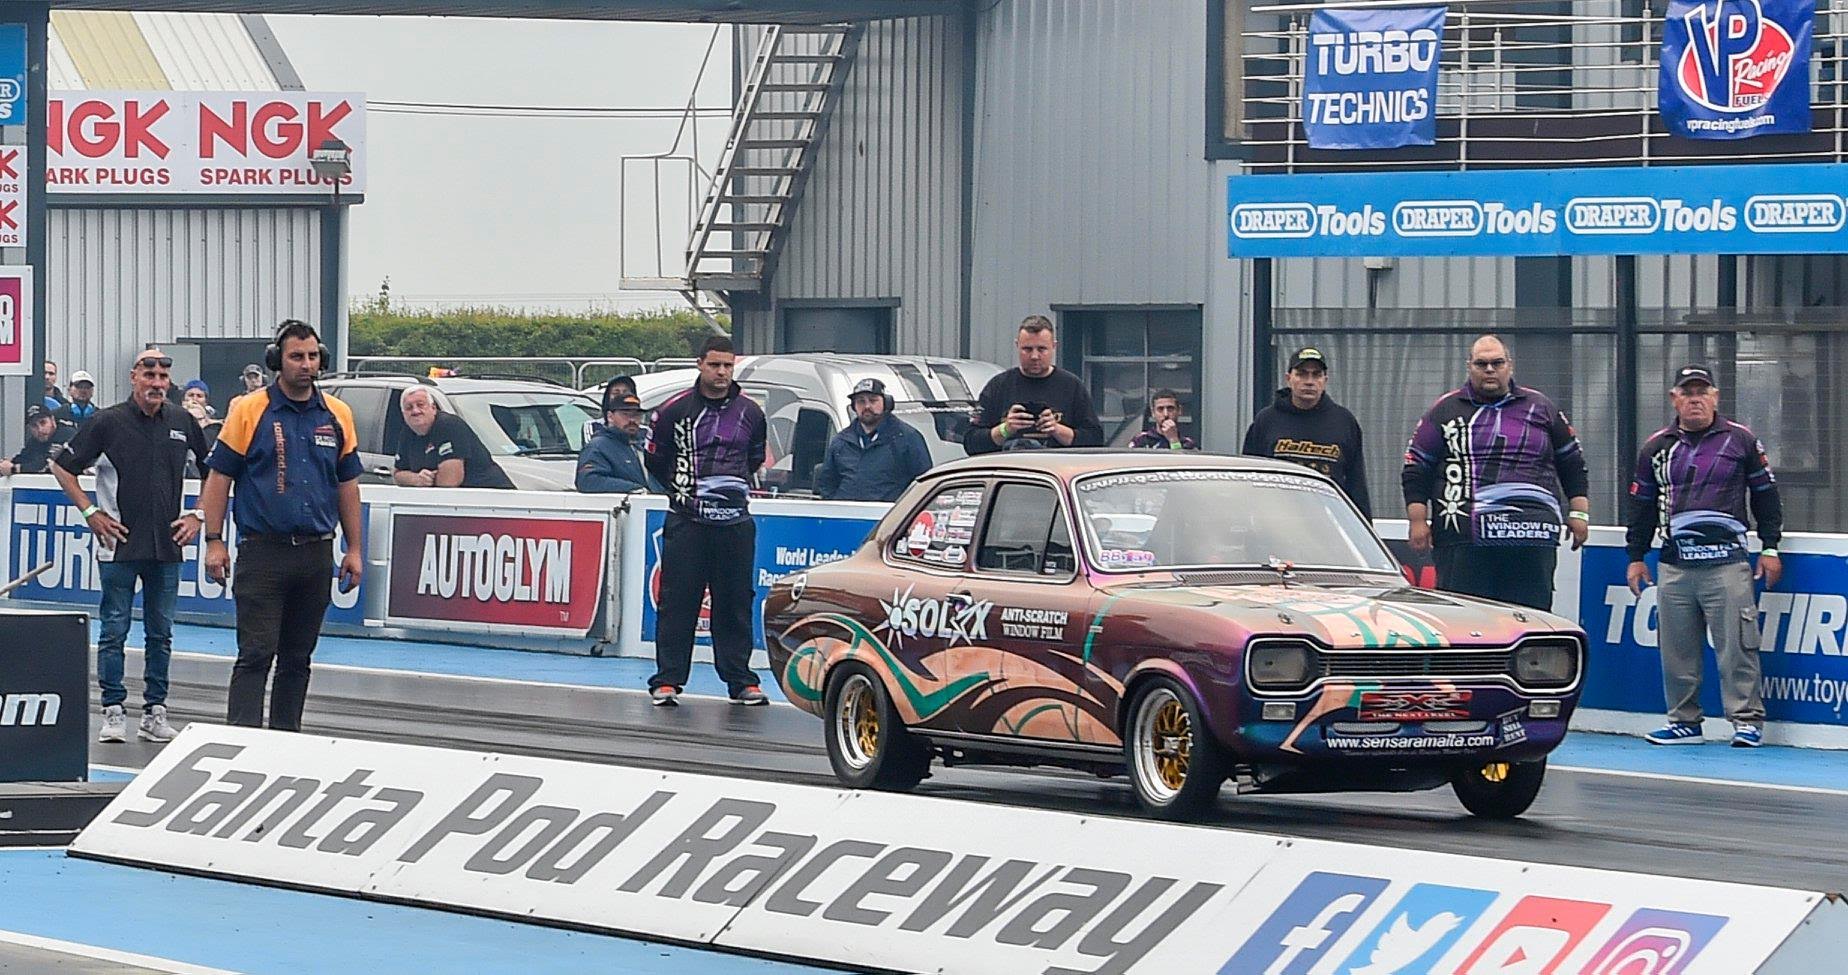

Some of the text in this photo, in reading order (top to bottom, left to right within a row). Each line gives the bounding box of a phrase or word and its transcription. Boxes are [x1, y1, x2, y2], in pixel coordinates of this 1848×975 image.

[1313, 29, 1438, 75] TURBO
[1684, 0, 1763, 109] VP
[1735, 51, 1791, 92] Racing
[1308, 88, 1428, 124] TECHNICS
[199, 100, 353, 159] NGK
[46, 168, 170, 185] ARK PLUGS
[200, 168, 273, 185] SPARK
[1239, 199, 1836, 236] DRAPER Tools DRAPER Tools DRAPER Tools DRAPER
[1275, 439, 1340, 458] Haltech
[1487, 522, 1541, 531] WINDOW
[1488, 514, 1509, 522] THE
[14, 503, 101, 590] TUR
[1488, 530, 1550, 539] LEADERS
[417, 533, 572, 603] AUTOGLYM
[776, 547, 807, 565] World
[1682, 551, 1728, 560] LEADERS
[1001, 608, 1068, 624] ANTI-SCRATCH
[1759, 591, 1848, 656] TIR
[1002, 623, 1064, 640] WINDOW FILM
[1760, 673, 1848, 712] www.toy
[1327, 734, 1494, 749] www.sensaramalta.com
[111, 742, 1226, 975] Santa Pod Raceway
